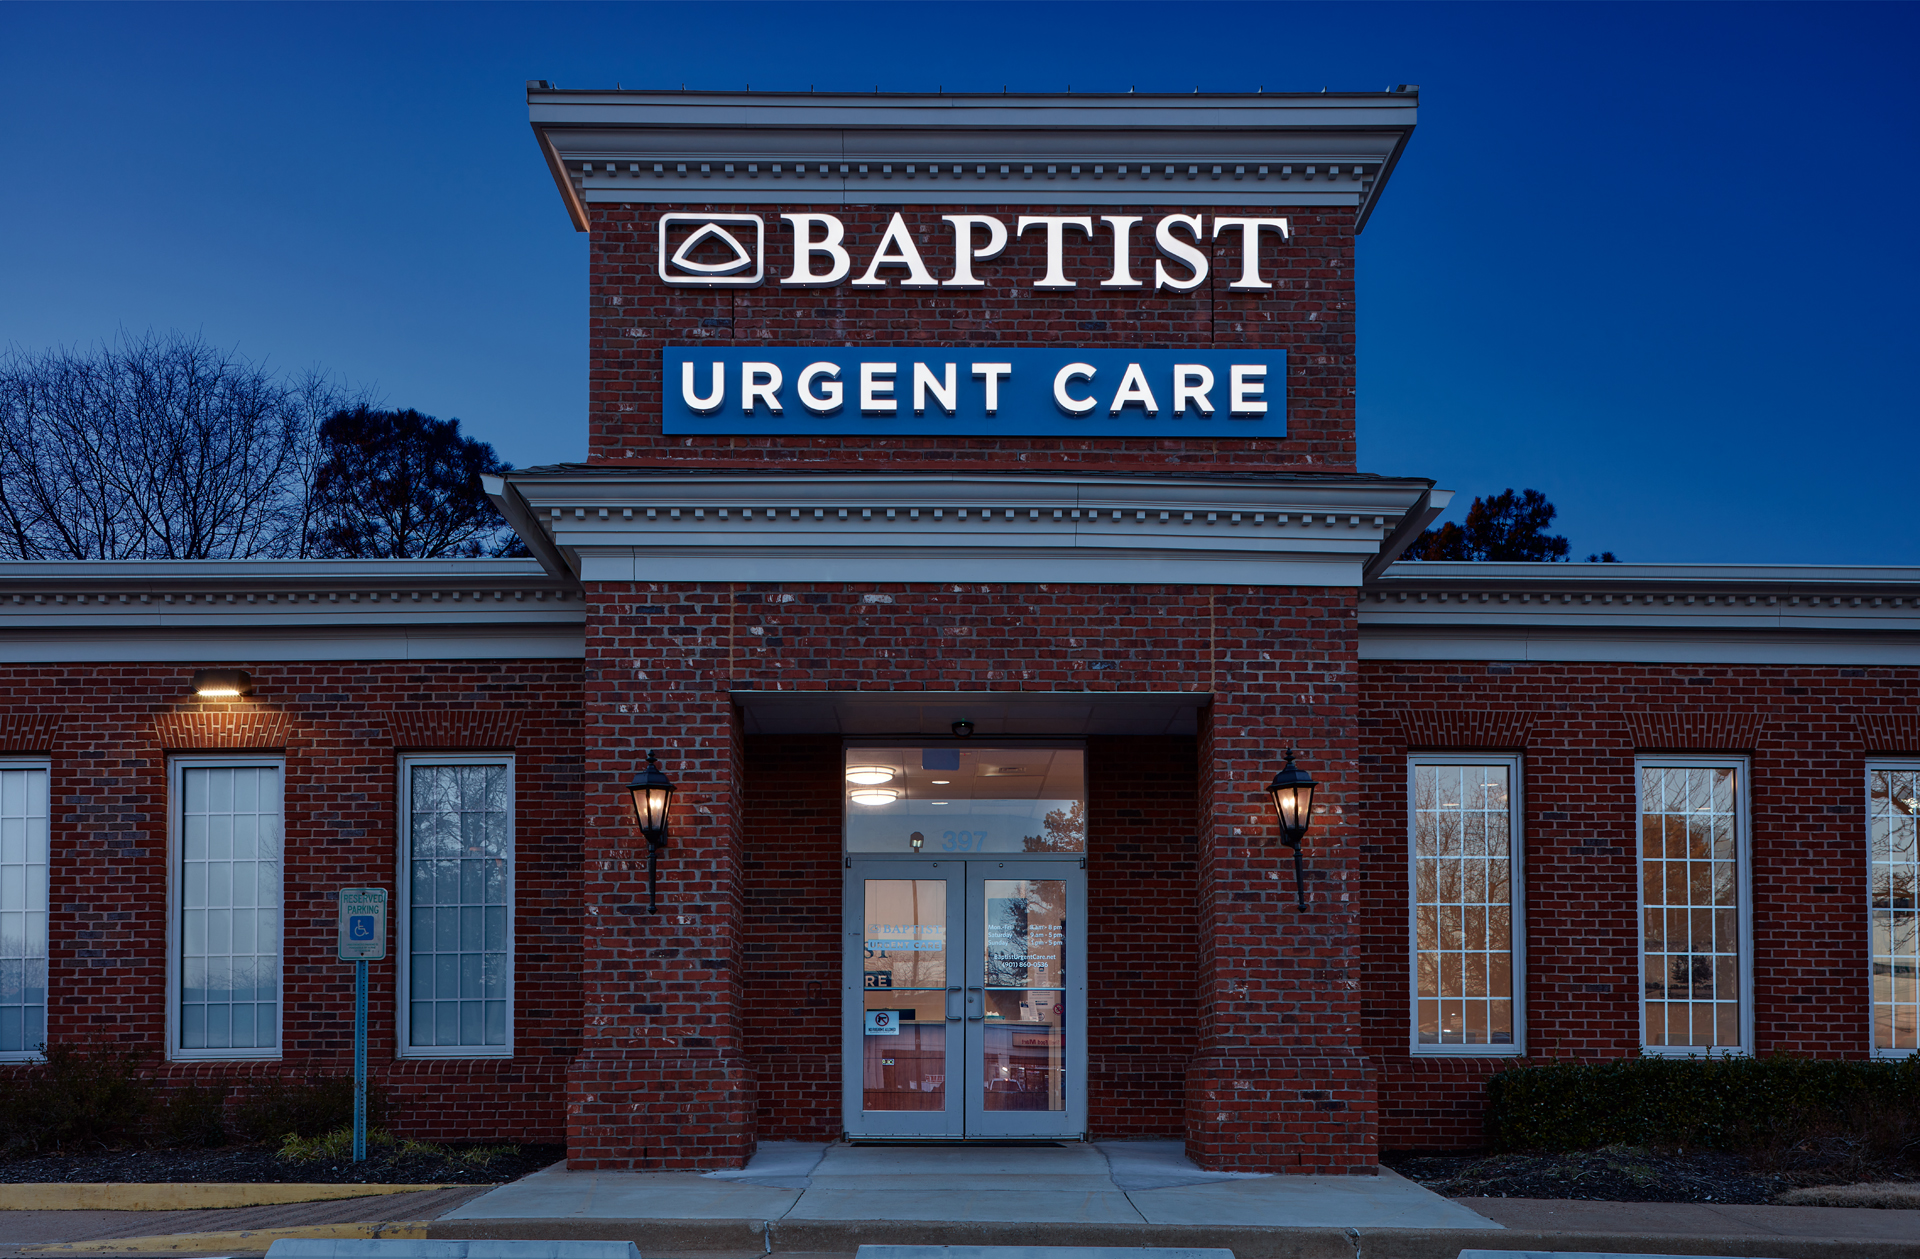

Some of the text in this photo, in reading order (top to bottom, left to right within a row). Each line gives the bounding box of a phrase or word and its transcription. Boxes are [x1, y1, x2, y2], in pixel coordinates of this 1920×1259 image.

[779, 211, 1289, 293] BAPTIST
[681, 361, 1268, 416] URGENT CARE
[942, 830, 988, 852] 397
[344, 894, 383, 903] RESERVED
[348, 905, 379, 914] PARKING
